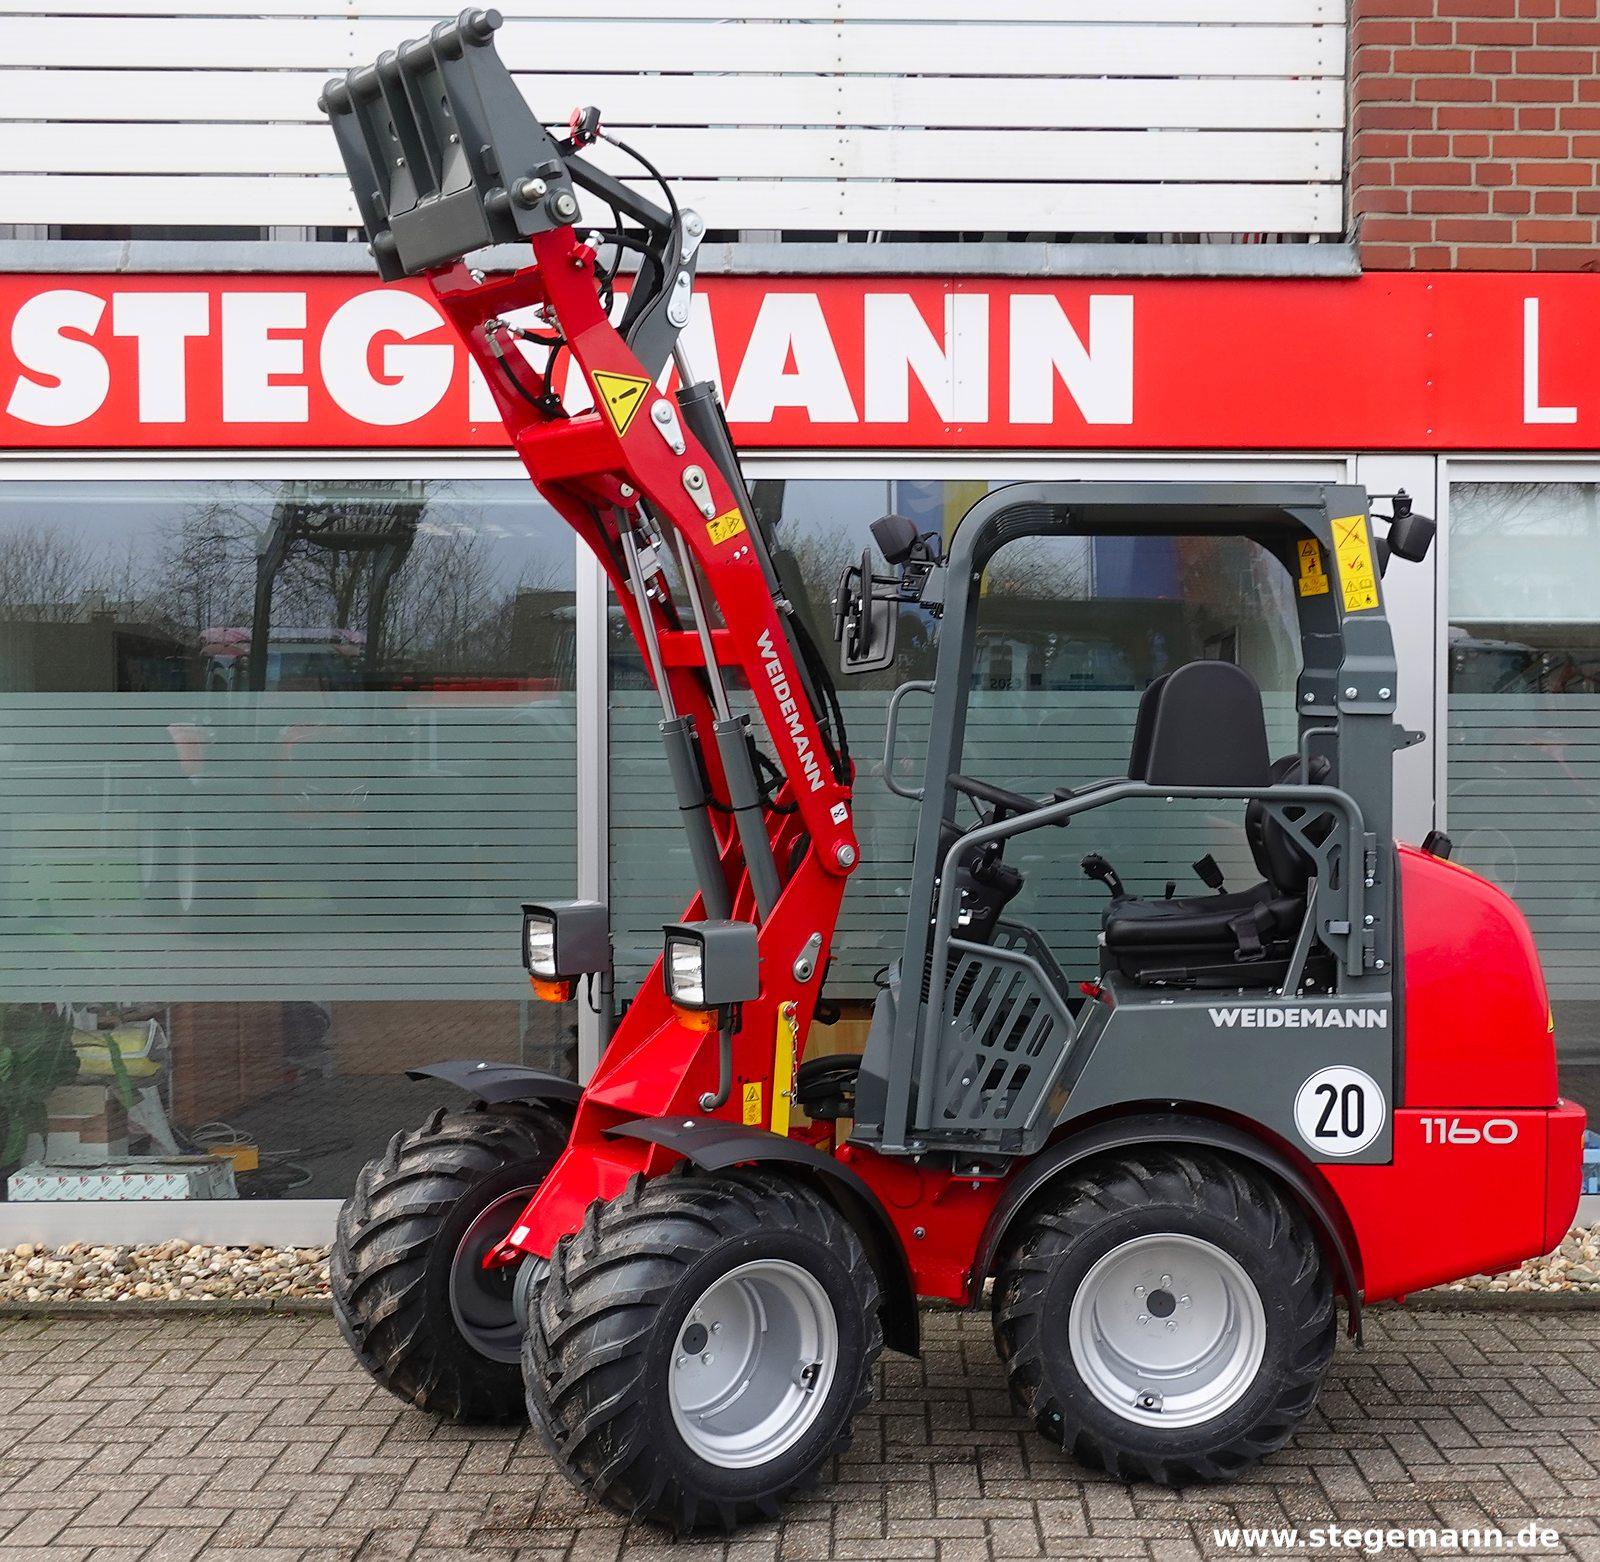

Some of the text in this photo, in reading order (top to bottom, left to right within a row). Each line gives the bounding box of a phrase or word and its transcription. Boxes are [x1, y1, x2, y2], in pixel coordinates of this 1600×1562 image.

[1523, 296, 1578, 424] L
[756, 628, 826, 793] WEIDEMANN
[1208, 1008, 1388, 1029] WEIDEMANN
[1314, 1083, 1365, 1139] 20
[1419, 1117, 1518, 1145] 1160
